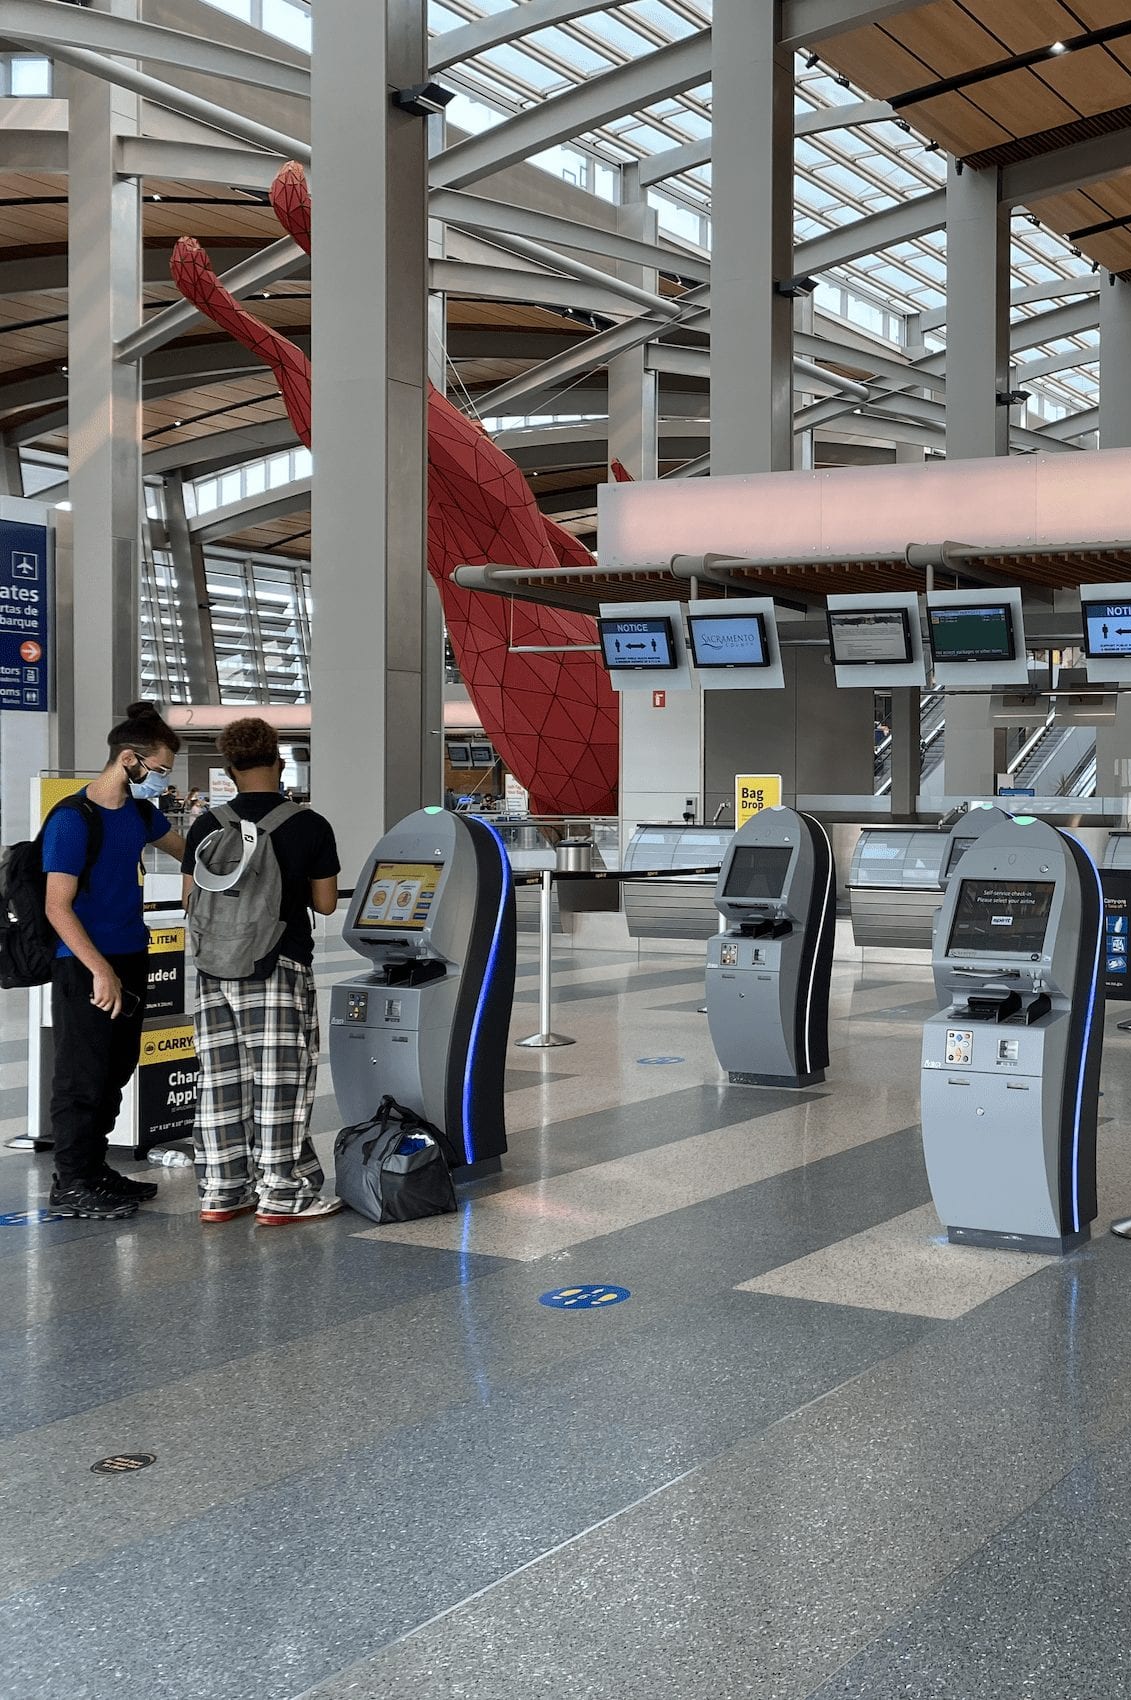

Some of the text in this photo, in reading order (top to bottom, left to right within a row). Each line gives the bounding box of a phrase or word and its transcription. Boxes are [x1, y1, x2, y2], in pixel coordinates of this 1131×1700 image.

[24, 606, 39, 617] de
[617, 623, 648, 633] NOTICE
[186, 709, 194, 726] 2
[742, 787, 764, 801] Bag
[742, 800, 764, 811] Drop
[157, 934, 177, 945] ITEM
